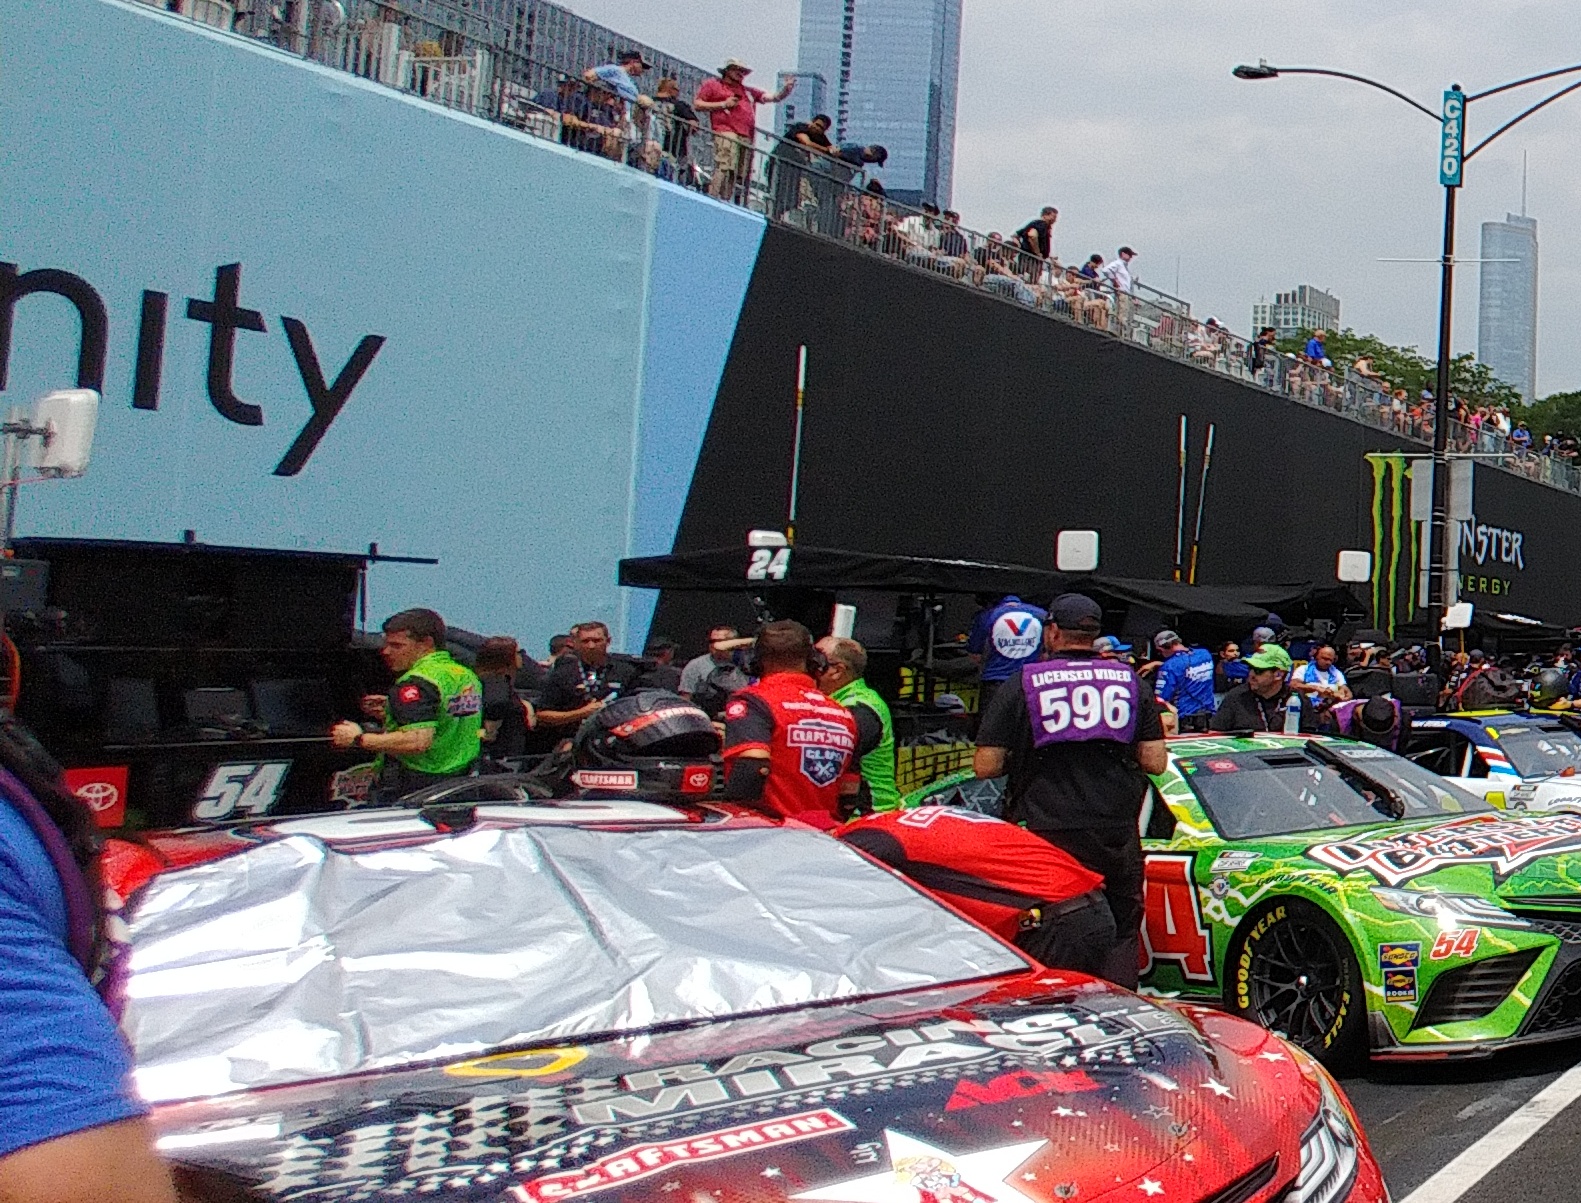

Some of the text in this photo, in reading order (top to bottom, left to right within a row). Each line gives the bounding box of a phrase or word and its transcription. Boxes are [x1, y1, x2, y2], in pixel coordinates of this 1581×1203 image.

[1443, 99, 1461, 176] C420
[747, 548, 791, 580] 24
[1458, 514, 1524, 571] NSTER
[1458, 574, 1511, 595] NERGY
[1031, 668, 1132, 688] LICENSED VIDEO
[1039, 685, 1131, 734] 596
[193, 760, 293, 820] 54
[1139, 854, 1215, 982] 4
[1429, 927, 1481, 961] 54
[1237, 905, 1288, 1010] GOODYEAR
[624, 1013, 1080, 1092] RACING
[537, 1114, 830, 1199] CRAFTSMAN
